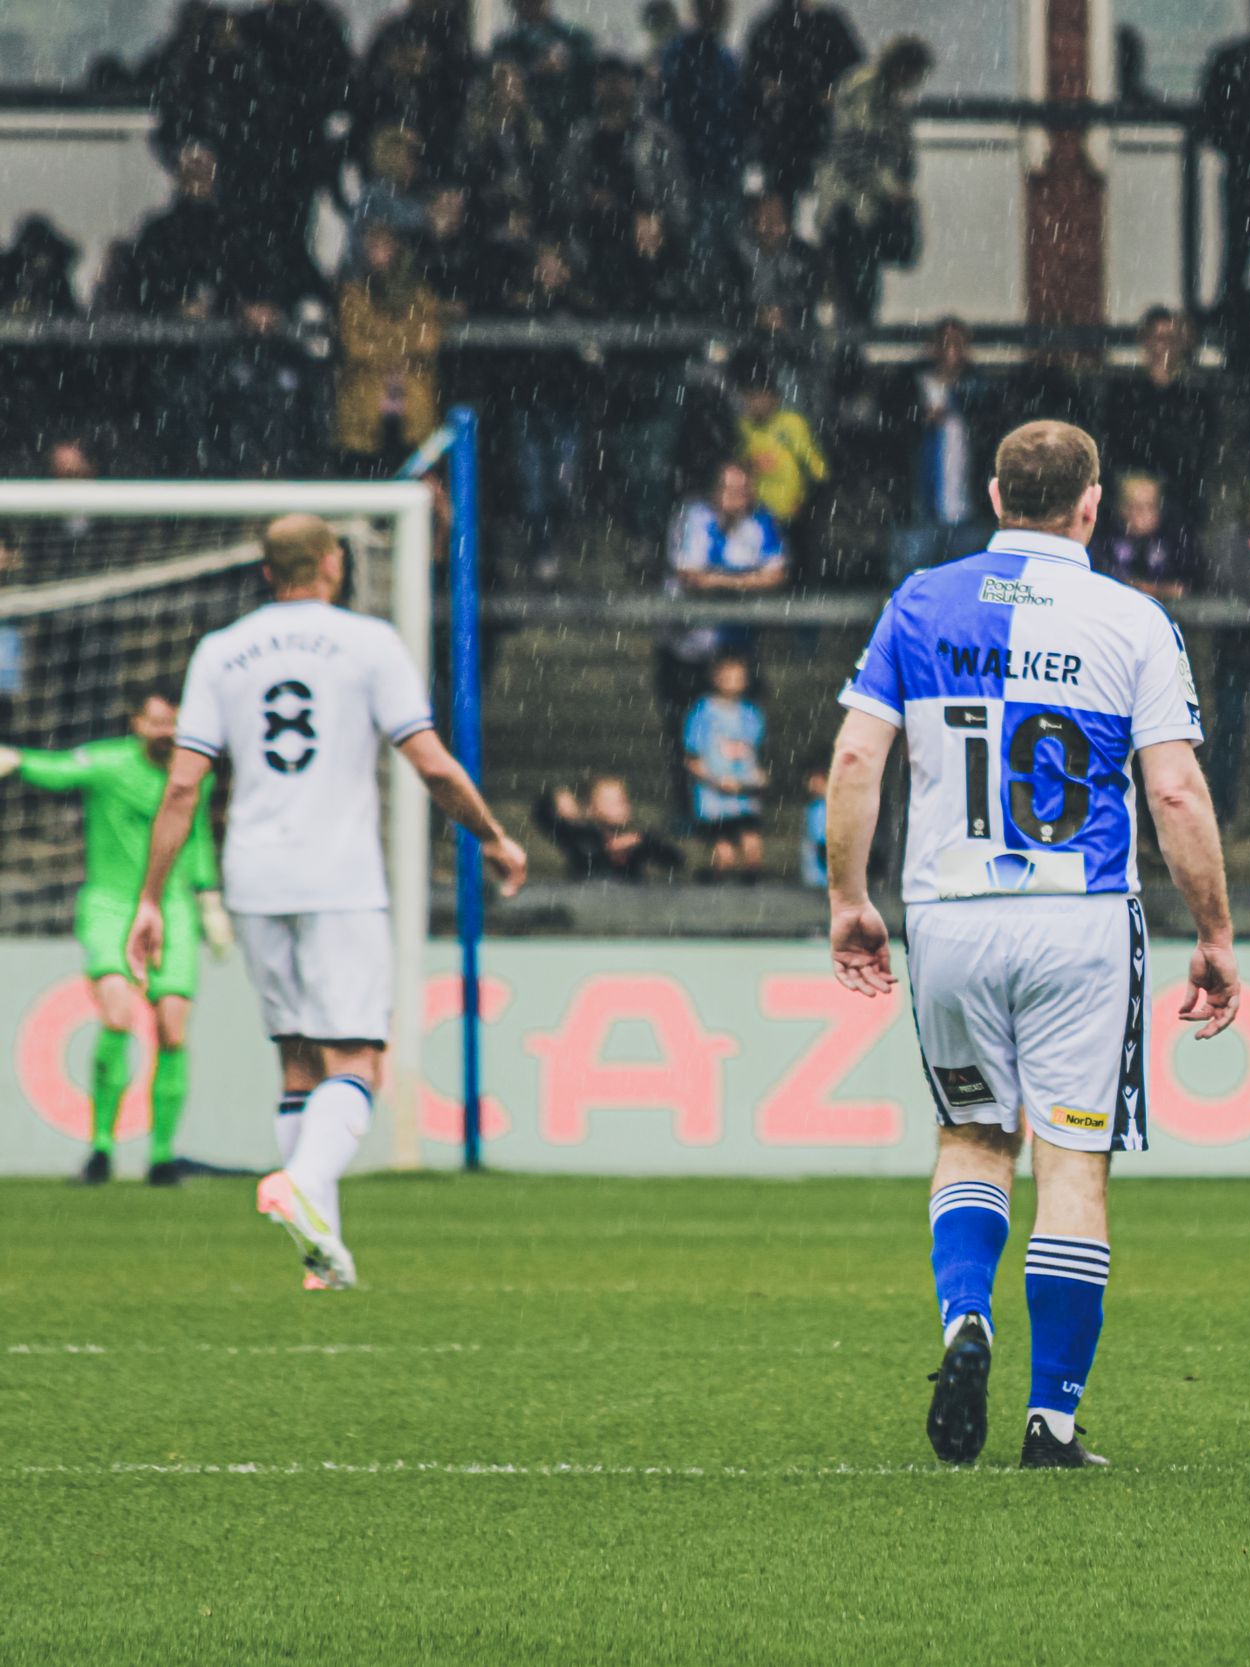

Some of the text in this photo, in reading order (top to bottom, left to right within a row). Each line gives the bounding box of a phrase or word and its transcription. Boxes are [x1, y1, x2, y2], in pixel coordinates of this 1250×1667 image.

[982, 586, 1055, 607] Insulation
[984, 578, 1034, 596] Poplar
[951, 645, 1082, 686] WALKER
[263, 680, 317, 774] 8
[943, 705, 1091, 845] 10
[1065, 1113, 1105, 1128] NorDan
